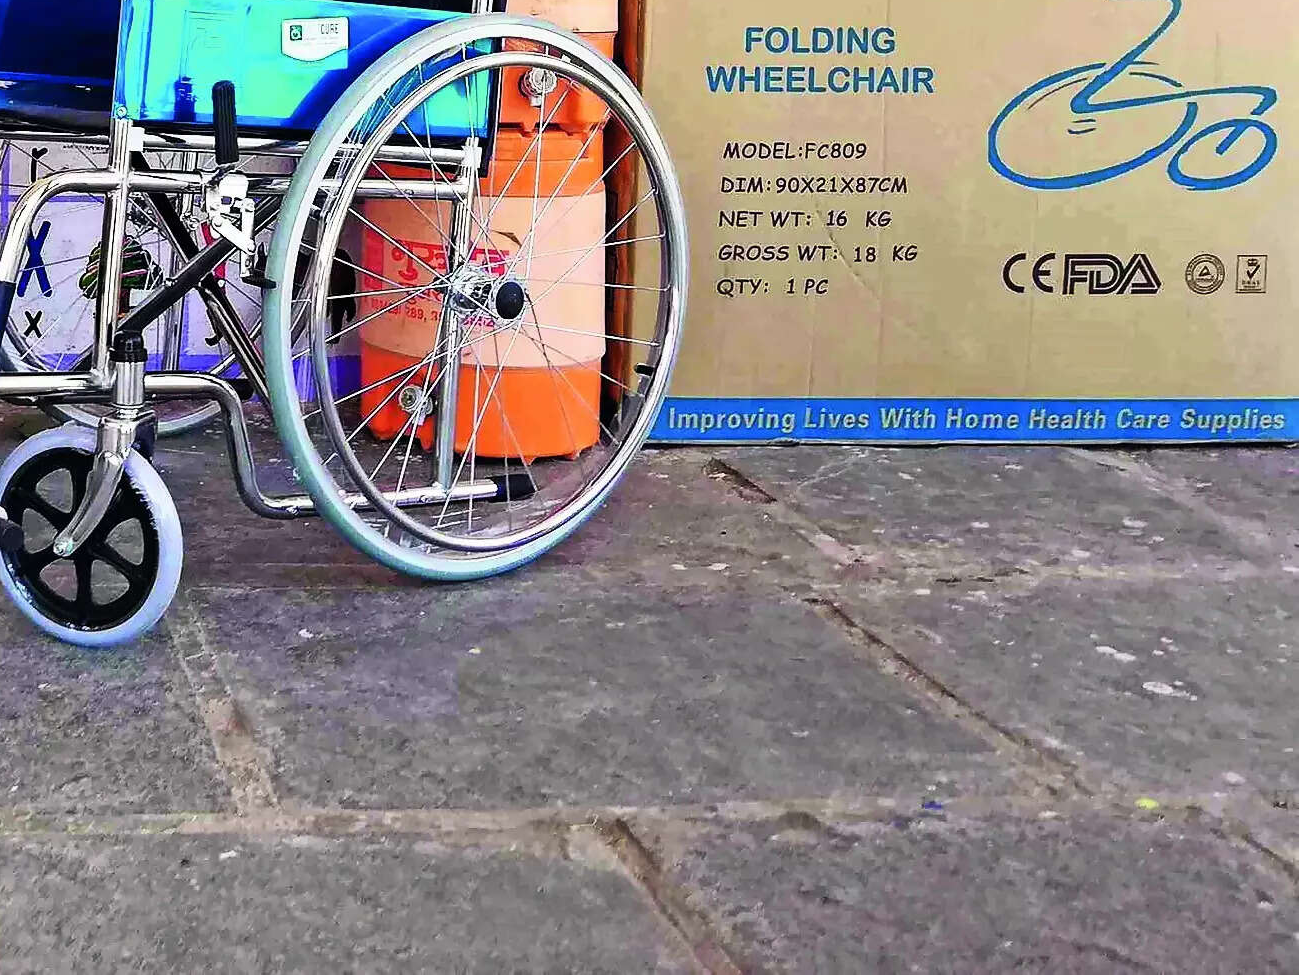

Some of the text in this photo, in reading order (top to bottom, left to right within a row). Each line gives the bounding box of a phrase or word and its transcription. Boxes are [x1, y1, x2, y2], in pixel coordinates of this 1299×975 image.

[744, 26, 897, 56] FOLDING
[706, 66, 936, 95] WHEELCHAIR
[718, 210, 892, 229] NET WT: 16 KG
[17, 221, 51, 297] X
[718, 244, 919, 264] GROSS WT: 18 KG
[717, 278, 829, 297] QTY: 1 PC
[1002, 253, 1162, 295] CE FDA
[668, 406, 1286, 433] Improving Lives With Home Health Care Supplies
